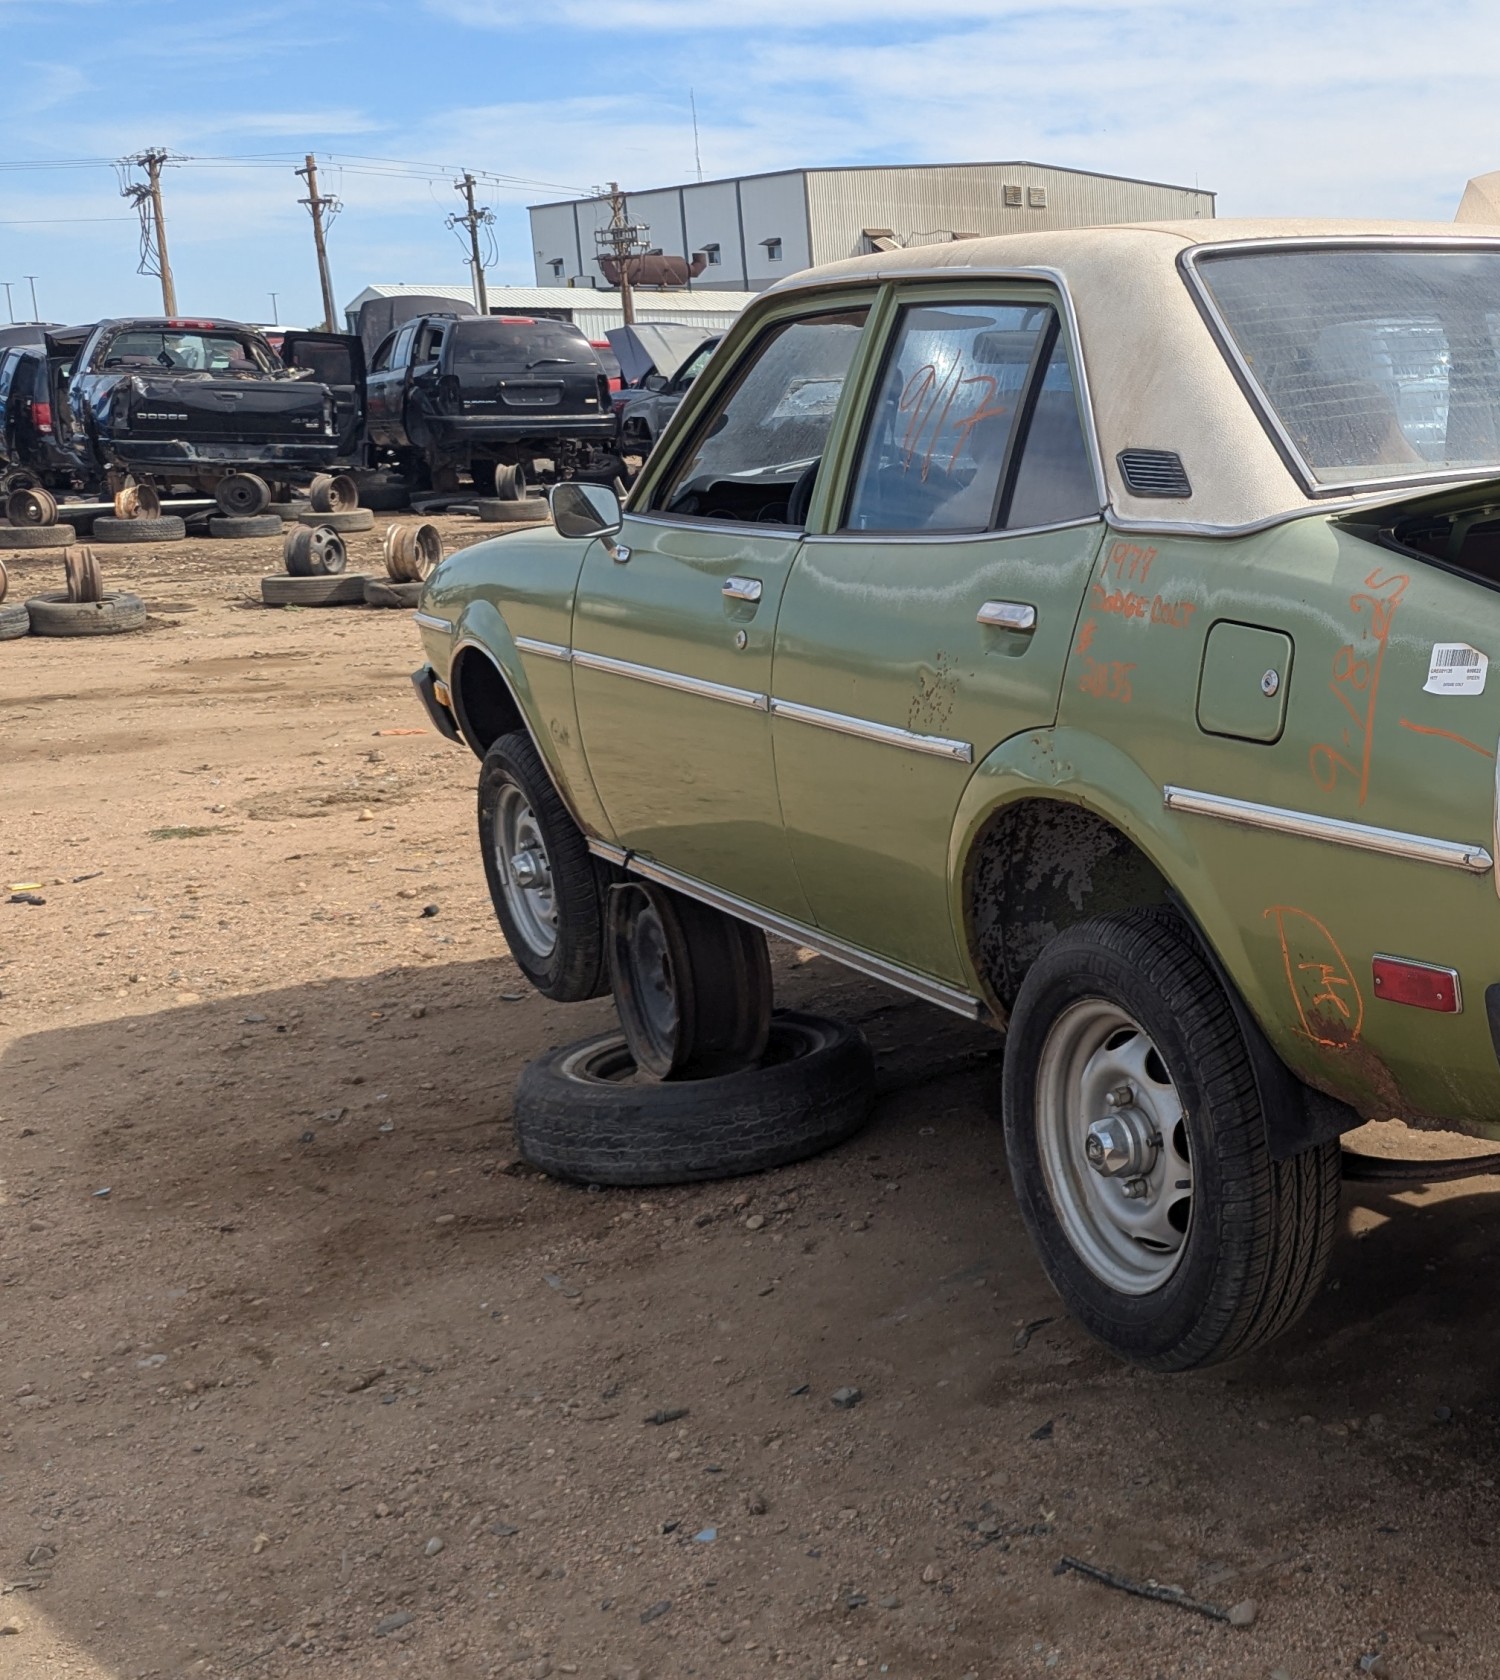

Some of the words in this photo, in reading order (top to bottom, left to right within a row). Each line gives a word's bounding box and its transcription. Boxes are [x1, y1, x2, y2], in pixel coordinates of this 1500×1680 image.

[137, 412, 188, 421] DODGE
[1090, 583, 1149, 619] DODGE
[1150, 594, 1197, 629] COLT
